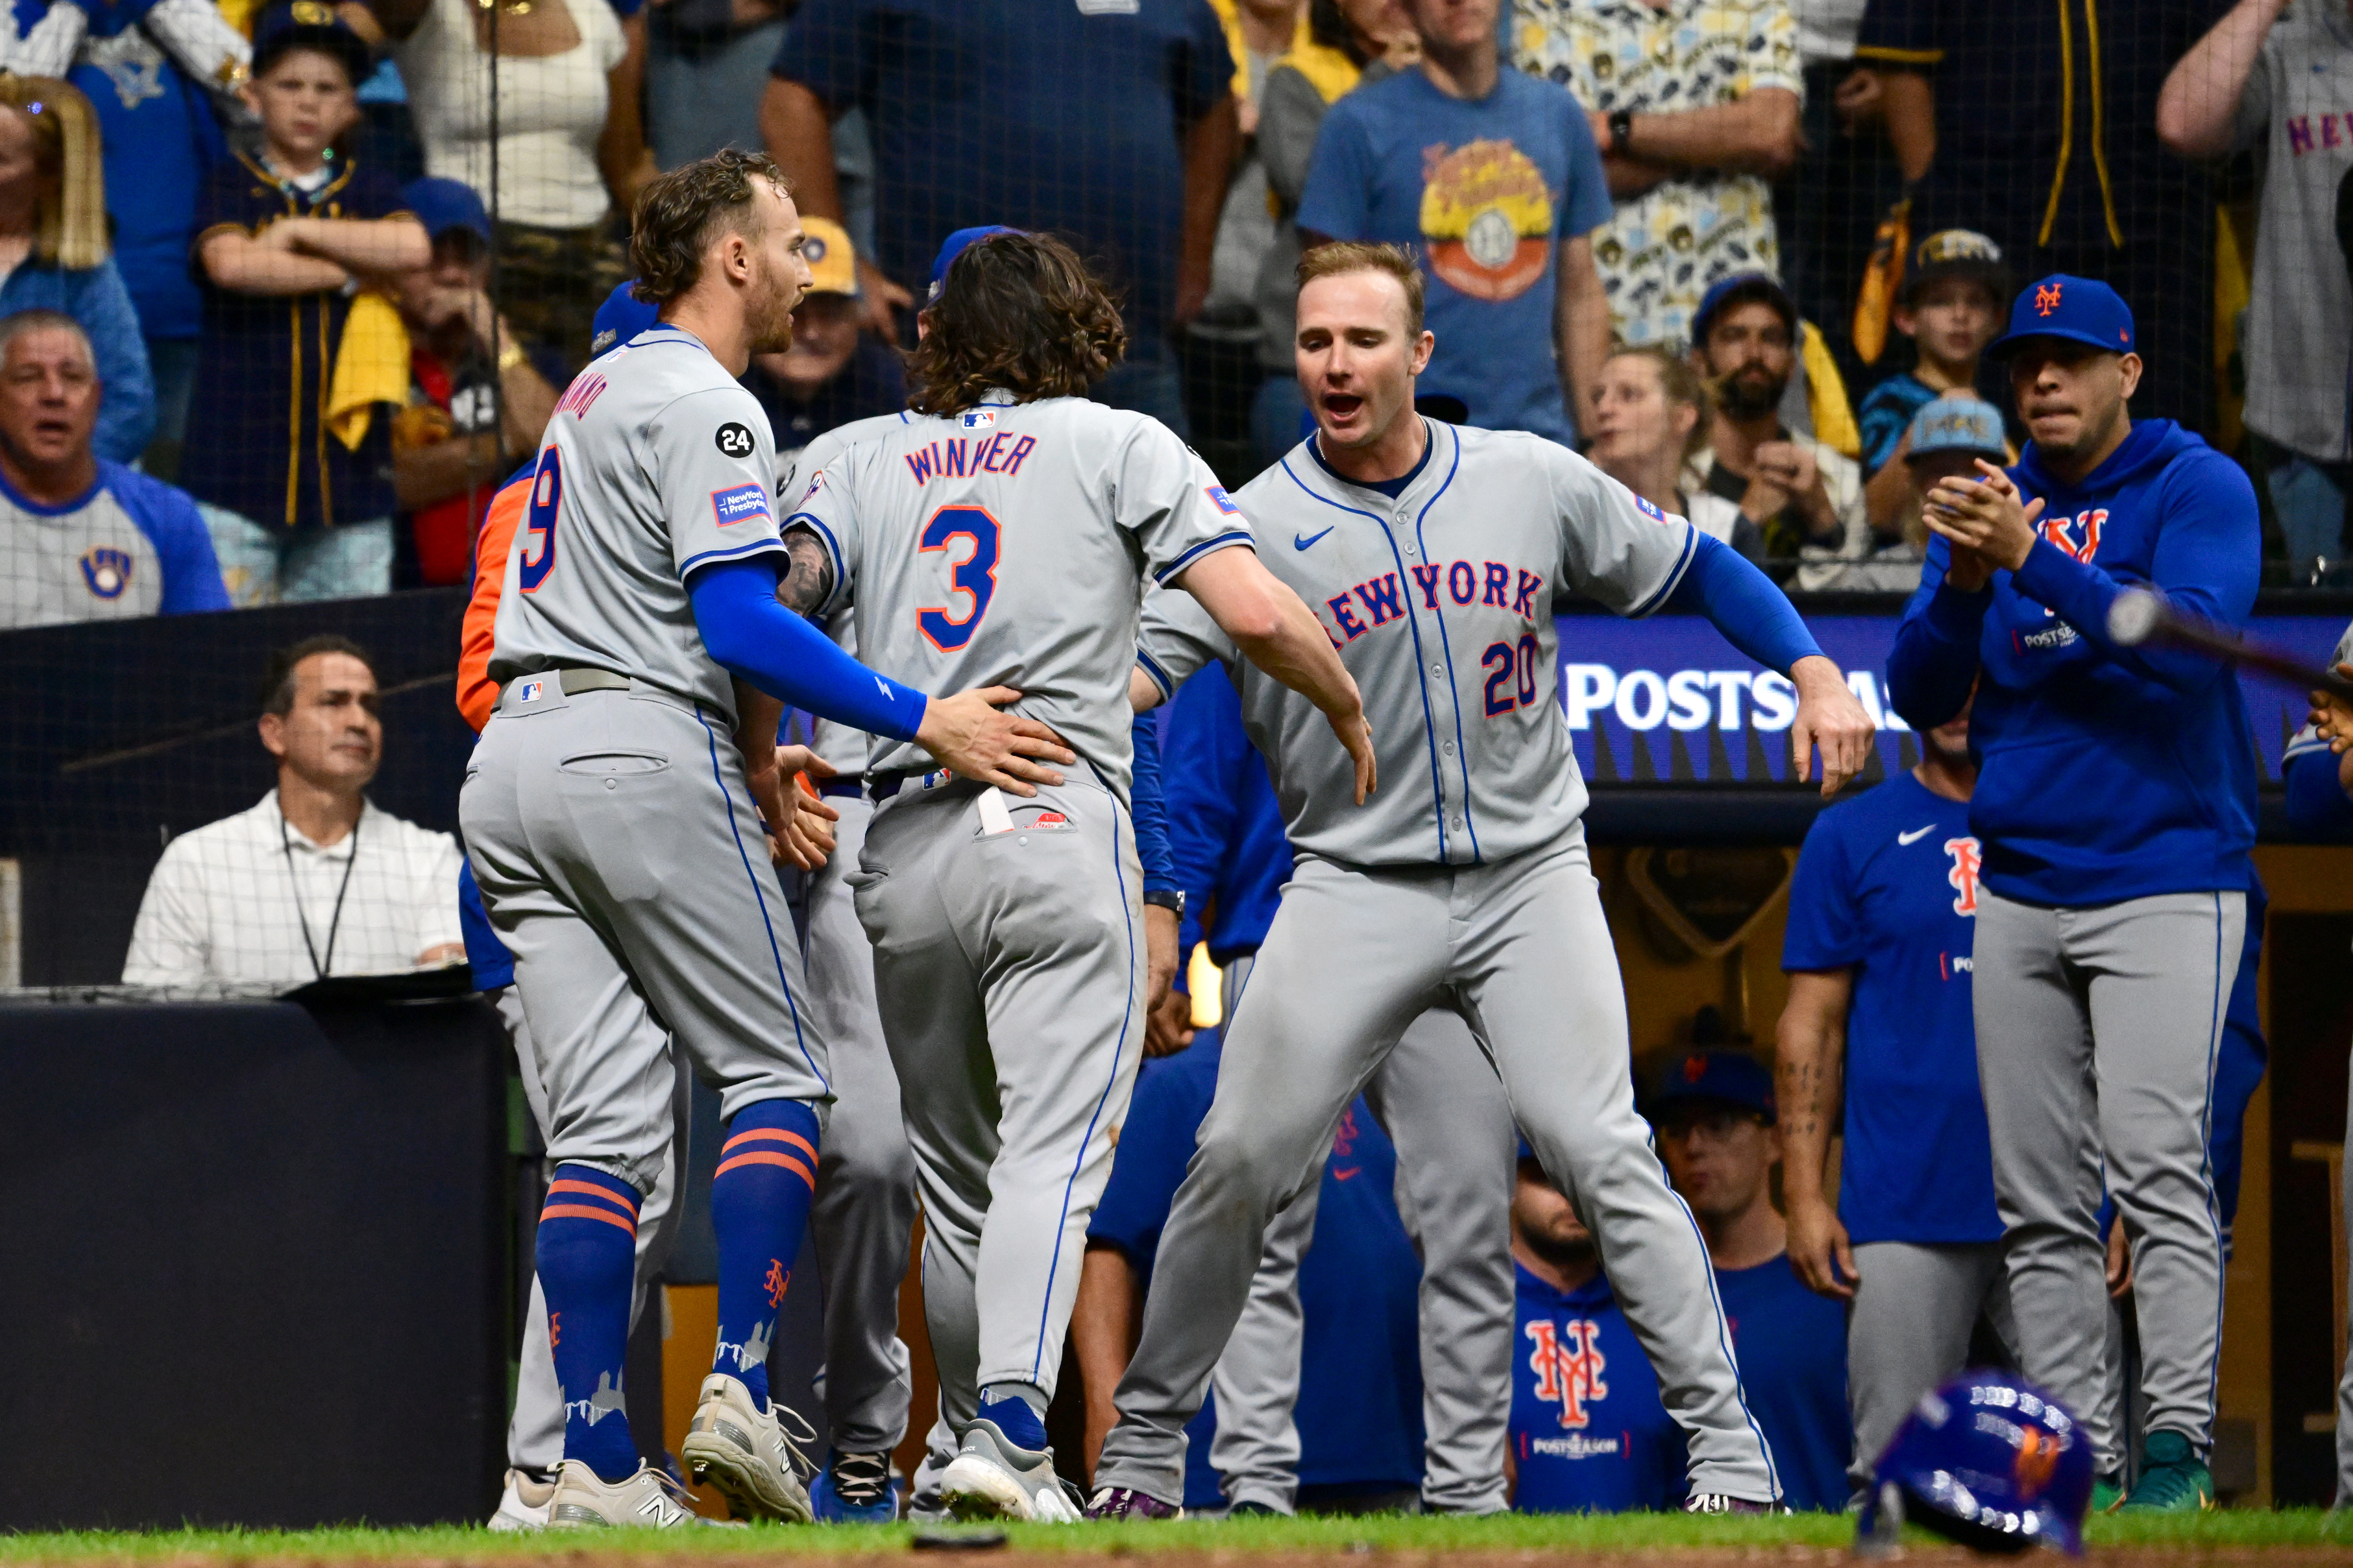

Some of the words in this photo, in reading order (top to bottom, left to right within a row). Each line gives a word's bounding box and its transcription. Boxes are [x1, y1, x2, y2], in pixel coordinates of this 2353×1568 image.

[722, 429, 750, 451] 24
[904, 431, 1038, 487] WINKER
[519, 443, 562, 594] 9
[916, 505, 1002, 653] 3
[1410, 559, 1543, 621] YORK
[1480, 633, 1539, 719] 20
